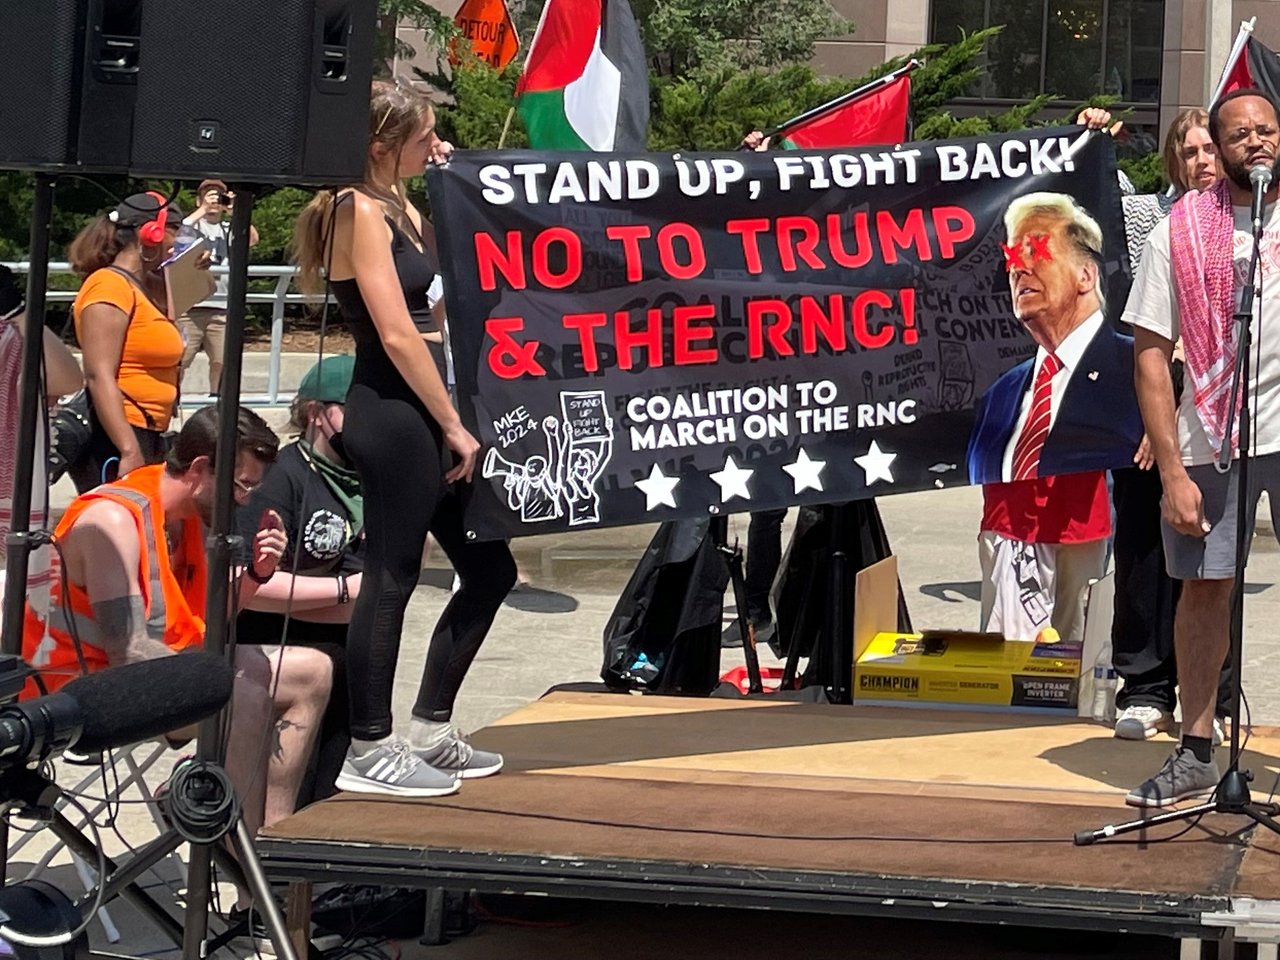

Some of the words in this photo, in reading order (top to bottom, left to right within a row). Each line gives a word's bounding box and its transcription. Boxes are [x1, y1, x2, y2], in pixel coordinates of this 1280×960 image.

[461, 18, 505, 43] DETOUR
[478, 159, 660, 205] STAND
[675, 158, 761, 200] UP,
[773, 150, 921, 190] FIGHT
[936, 137, 1076, 182] BACK!
[474, 227, 583, 291] NO
[606, 222, 707, 283] TO
[726, 206, 976, 274] TRUMP
[485, 317, 547, 379] &
[562, 304, 718, 373] THE
[747, 288, 919, 358] RNC!
[935, 316, 1026, 342] CONVEN
[570, 399, 601, 409] STAND
[580, 409, 593, 418] UP
[627, 383, 788, 423] COALITION
[796, 380, 838, 407] TO
[493, 405, 530, 434] MKE
[574, 427, 601, 437] BACK
[629, 412, 739, 452] MARCH
[743, 408, 793, 440] ON
[796, 406, 853, 434] THE
[856, 399, 917, 429] RNC
[498, 418, 538, 449] 2024
[860, 674, 919, 690] CHAMPION
[1027, 689, 1064, 698] INVERTER
[1044, 682, 1070, 691] FRAME
